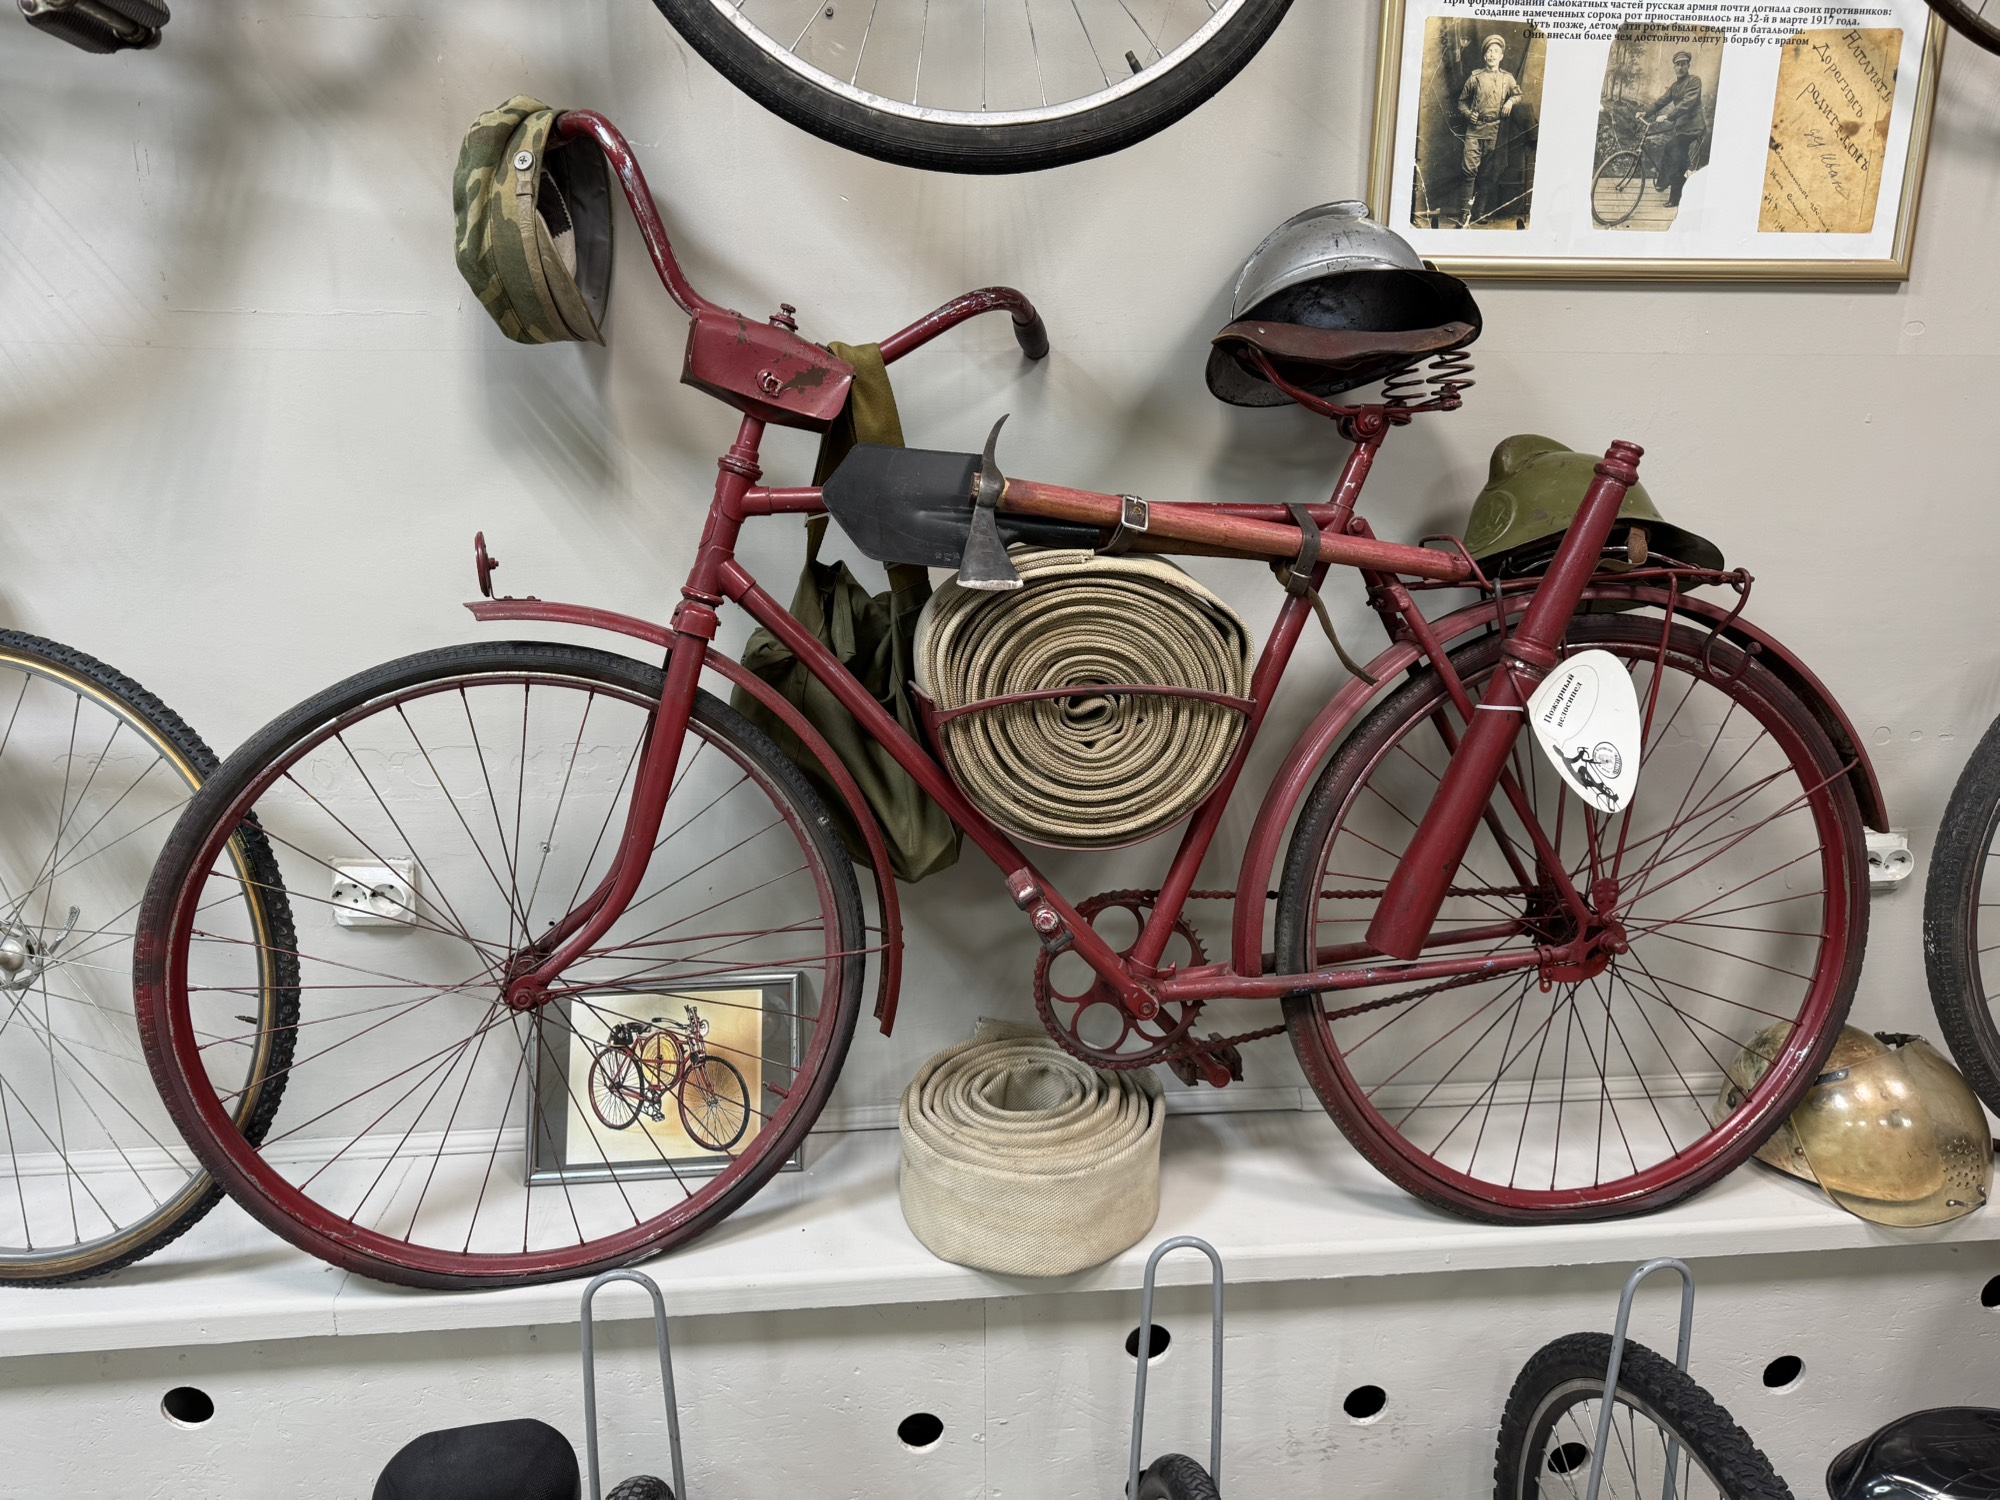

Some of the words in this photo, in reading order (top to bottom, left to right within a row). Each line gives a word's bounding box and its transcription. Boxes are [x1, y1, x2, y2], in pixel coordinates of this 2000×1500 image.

[1468, 0, 1545, 8] формировании
[1547, 0, 1608, 8] самокатных
[1610, 0, 1643, 9] частей
[1646, 2, 1685, 12] русская
[1687, 4, 1718, 13] армия
[1720, 4, 1750, 12] почти
[1752, 5, 1791, 13] догнала
[1793, 6, 1822, 14] своих
[1824, 7, 1892, 17] противников:
[1474, 8, 1520, 17] создание
[1522, 9, 1585, 18] намеченных
[1587, 11, 1622, 21] сорока
[1624, 12, 1642, 22] рот
[1644, 13, 1732, 23] приостановилось
[1747, 13, 1769, 24] 32-й
[1779, 16, 1808, 26] марте
[1810, 15, 1834, 25] 1917
[1836, 18, 1860, 27] года.
[1526, 18, 1550, 30] Чуть
[1552, 21, 1586, 31] позже,
[1588, 22, 1621, 32] летом,
[1623, 23, 1641, 31] эти
[1643, 24, 1669, 33] роты
[1671, 22, 1697, 32] были
[1699, 25, 1740, 34] сведены
[1750, 24, 1806, 35] батальоны.
[1522, 29, 1545, 39] Они
[1547, 31, 1582, 40] внесли
[1584, 30, 1612, 41] более
[1614, 33, 1632, 41] чем
[1634, 33, 1690, 45] достойную
[1692, 36, 1721, 46] лепту
[1730, 34, 1766, 47] борьбу
[1774, 38, 1809, 48] врагом
[1543, 673, 1575, 724] Пожарный
[1556, 681, 1583, 728] велосипед
